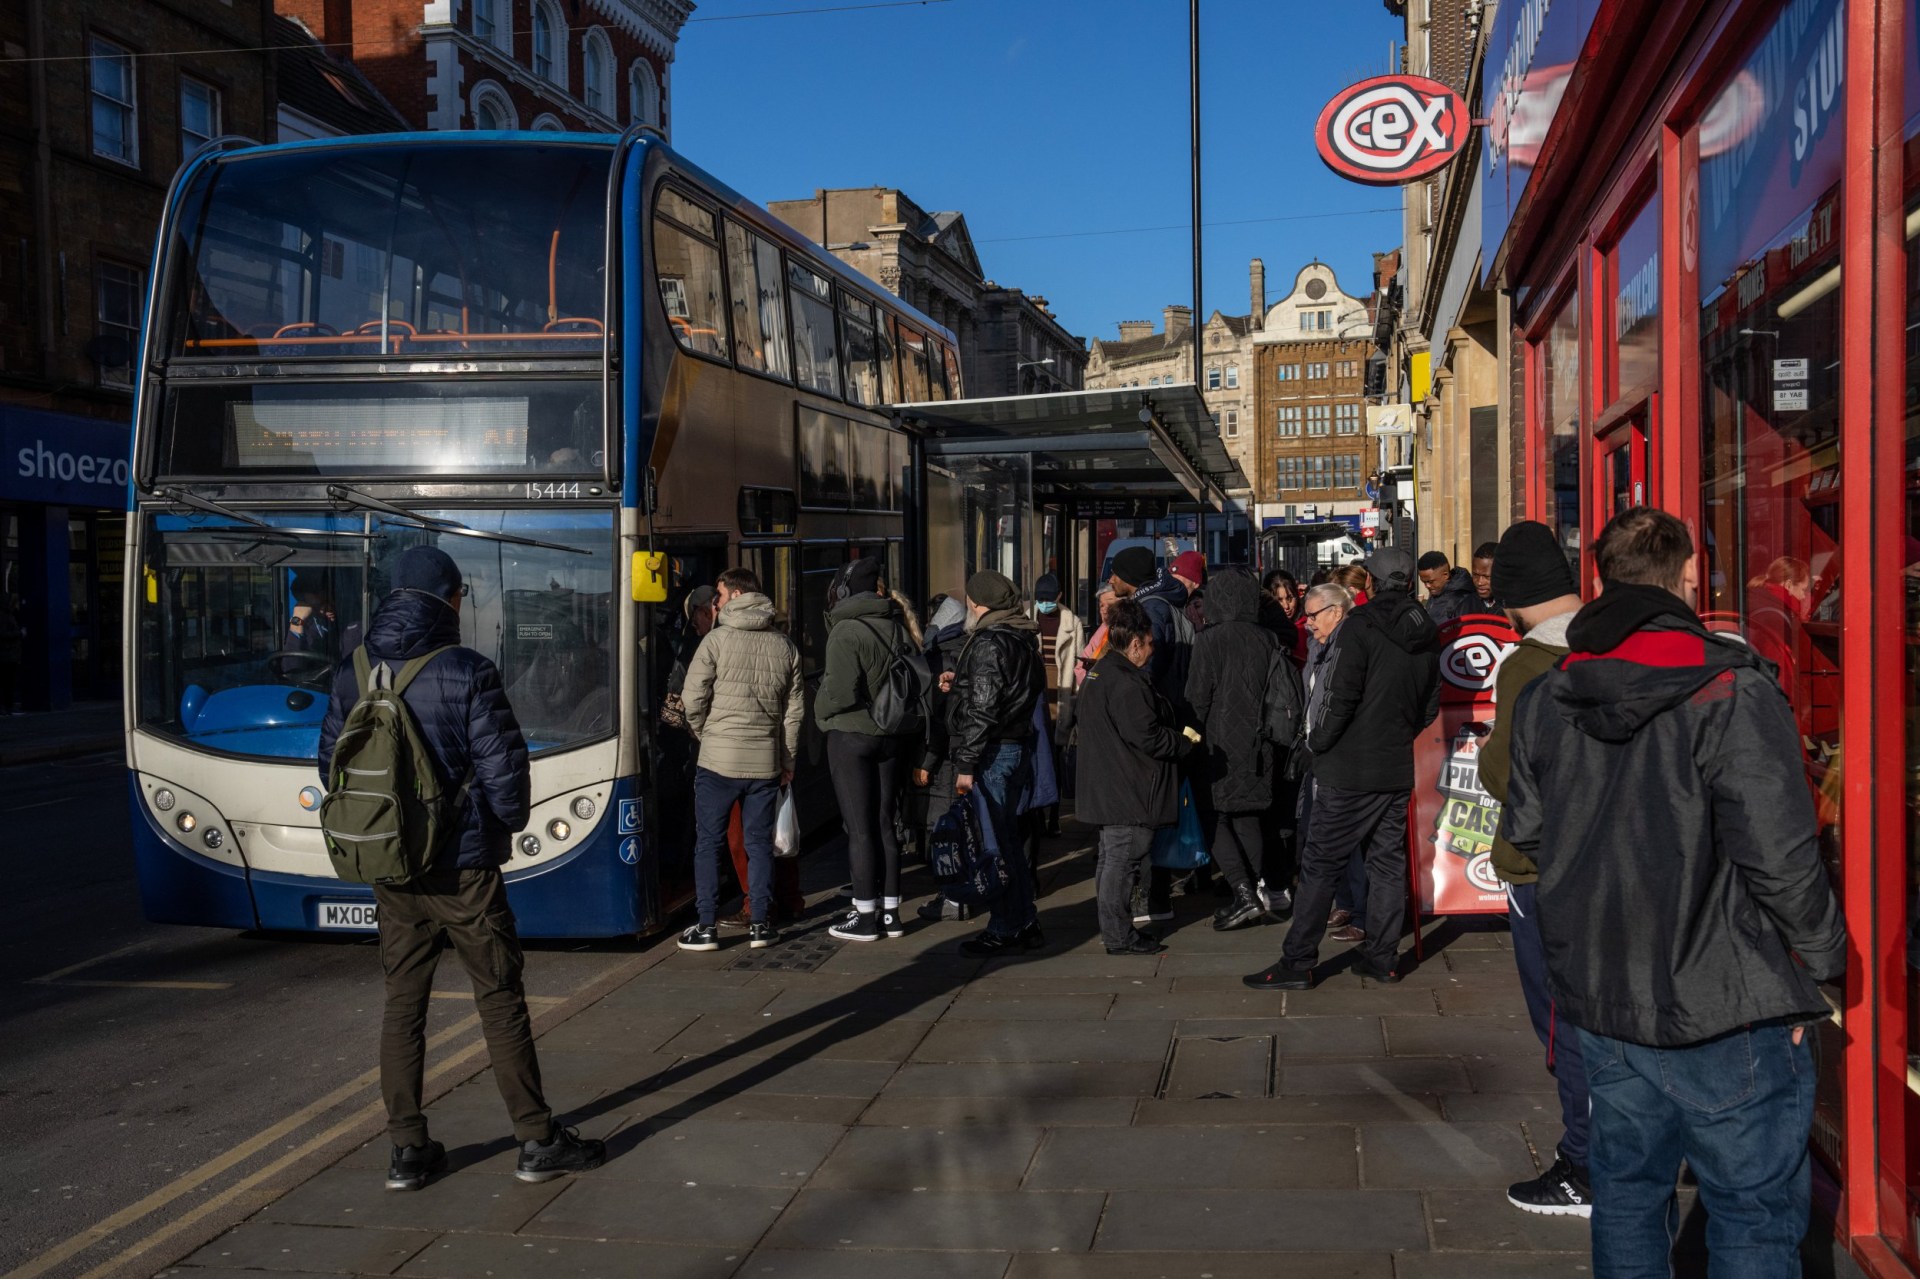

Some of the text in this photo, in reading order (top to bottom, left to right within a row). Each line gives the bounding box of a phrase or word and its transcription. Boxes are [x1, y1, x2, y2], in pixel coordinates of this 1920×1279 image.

[526, 482, 581, 499] 15444
[1456, 741, 1474, 753] WE
[1480, 795, 1496, 808] for
[326, 906, 375, 925] MX08
[1560, 1181, 1583, 1205] FILA
